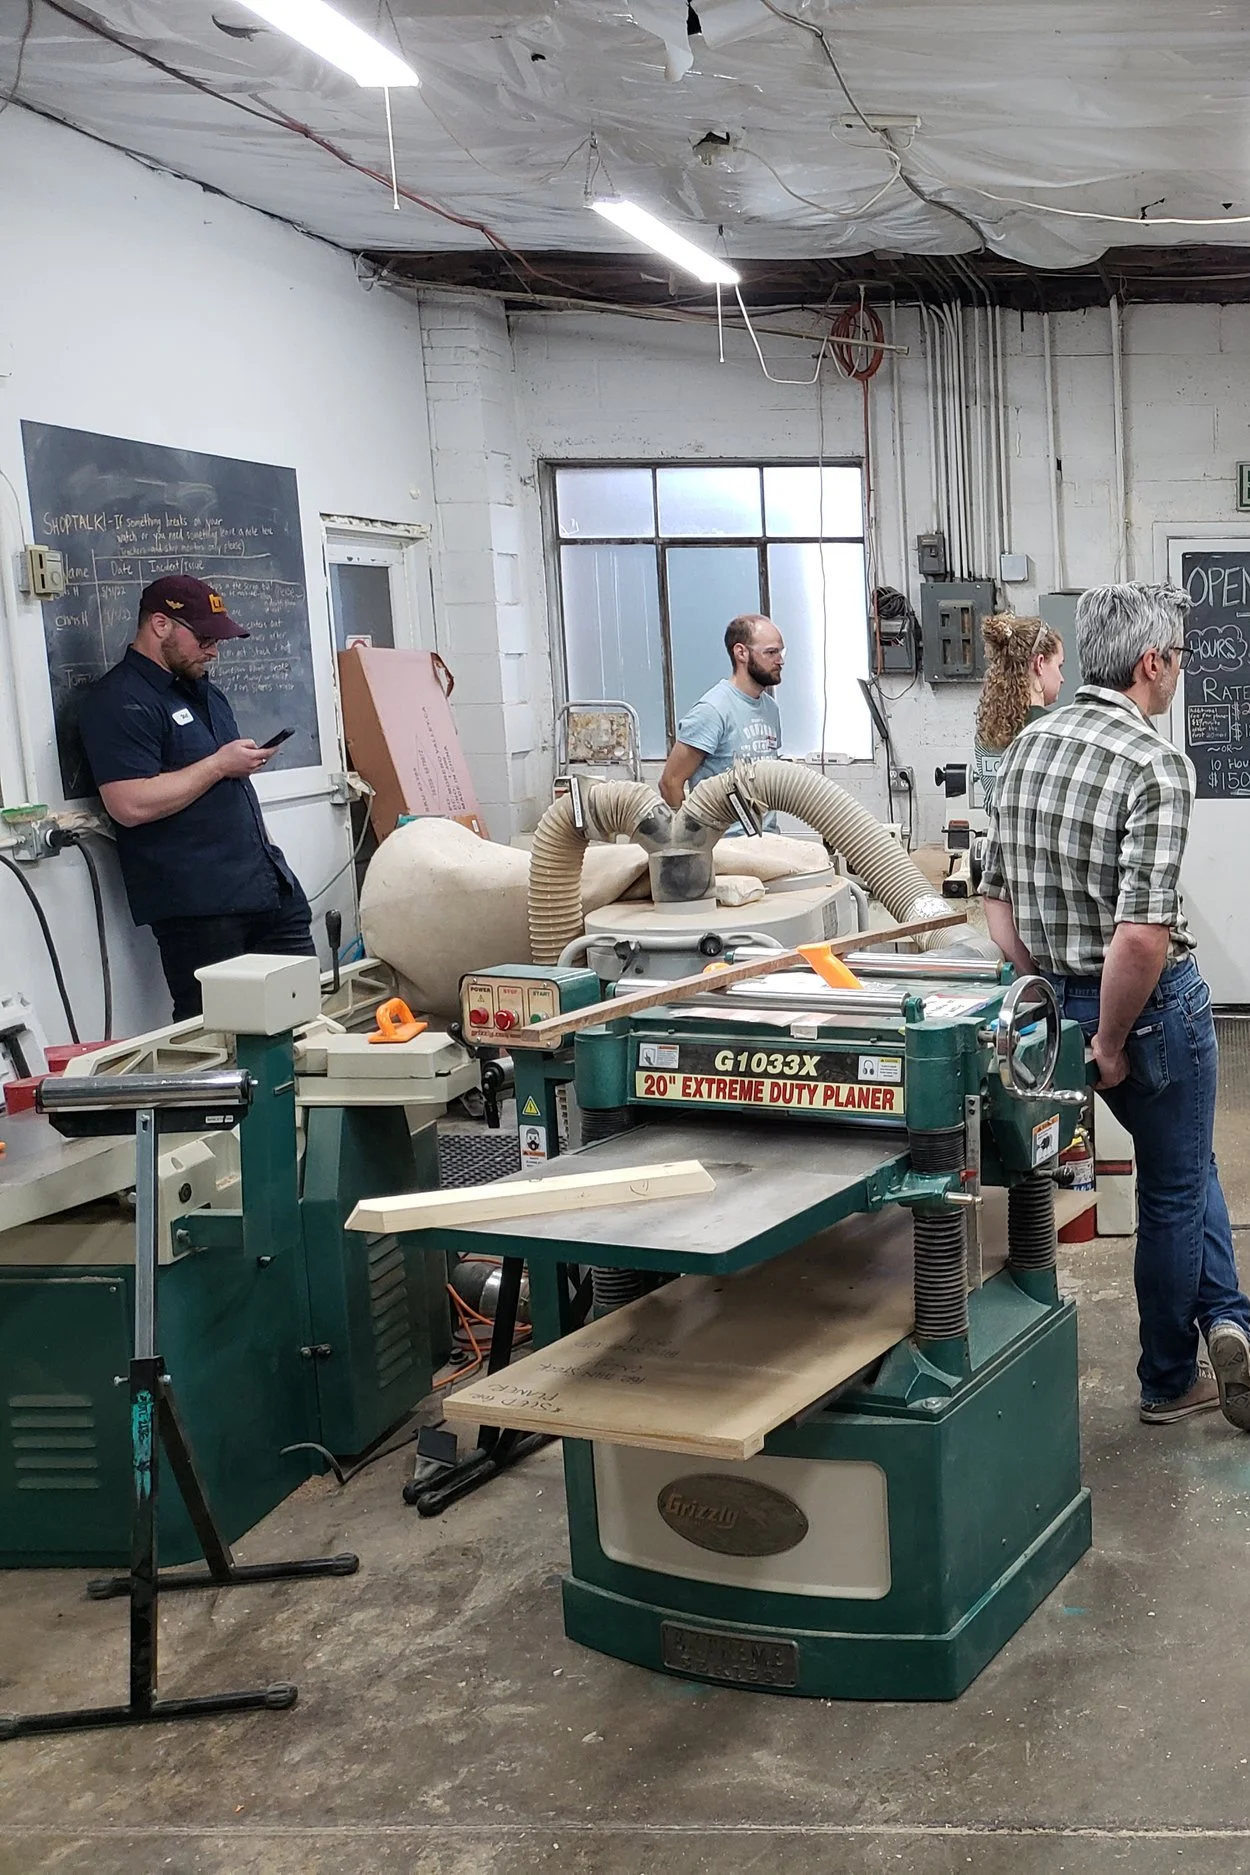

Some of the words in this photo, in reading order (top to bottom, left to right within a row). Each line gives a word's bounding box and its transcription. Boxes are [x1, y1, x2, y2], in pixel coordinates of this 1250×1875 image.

[43, 511, 106, 535] SHOPTALK!
[126, 513, 161, 533] something
[205, 518, 223, 532] your
[111, 560, 133, 576] Date
[1188, 637, 1237, 660] HOURS
[1211, 759, 1222, 770] 10
[714, 1050, 822, 1076] G1033X
[643, 1075, 676, 1097] 20"
[681, 1076, 764, 1102] EXTREME
[769, 1080, 818, 1106] DUTY
[822, 1087, 896, 1111] PLANER
[666, 1493, 739, 1529] Grizzly
